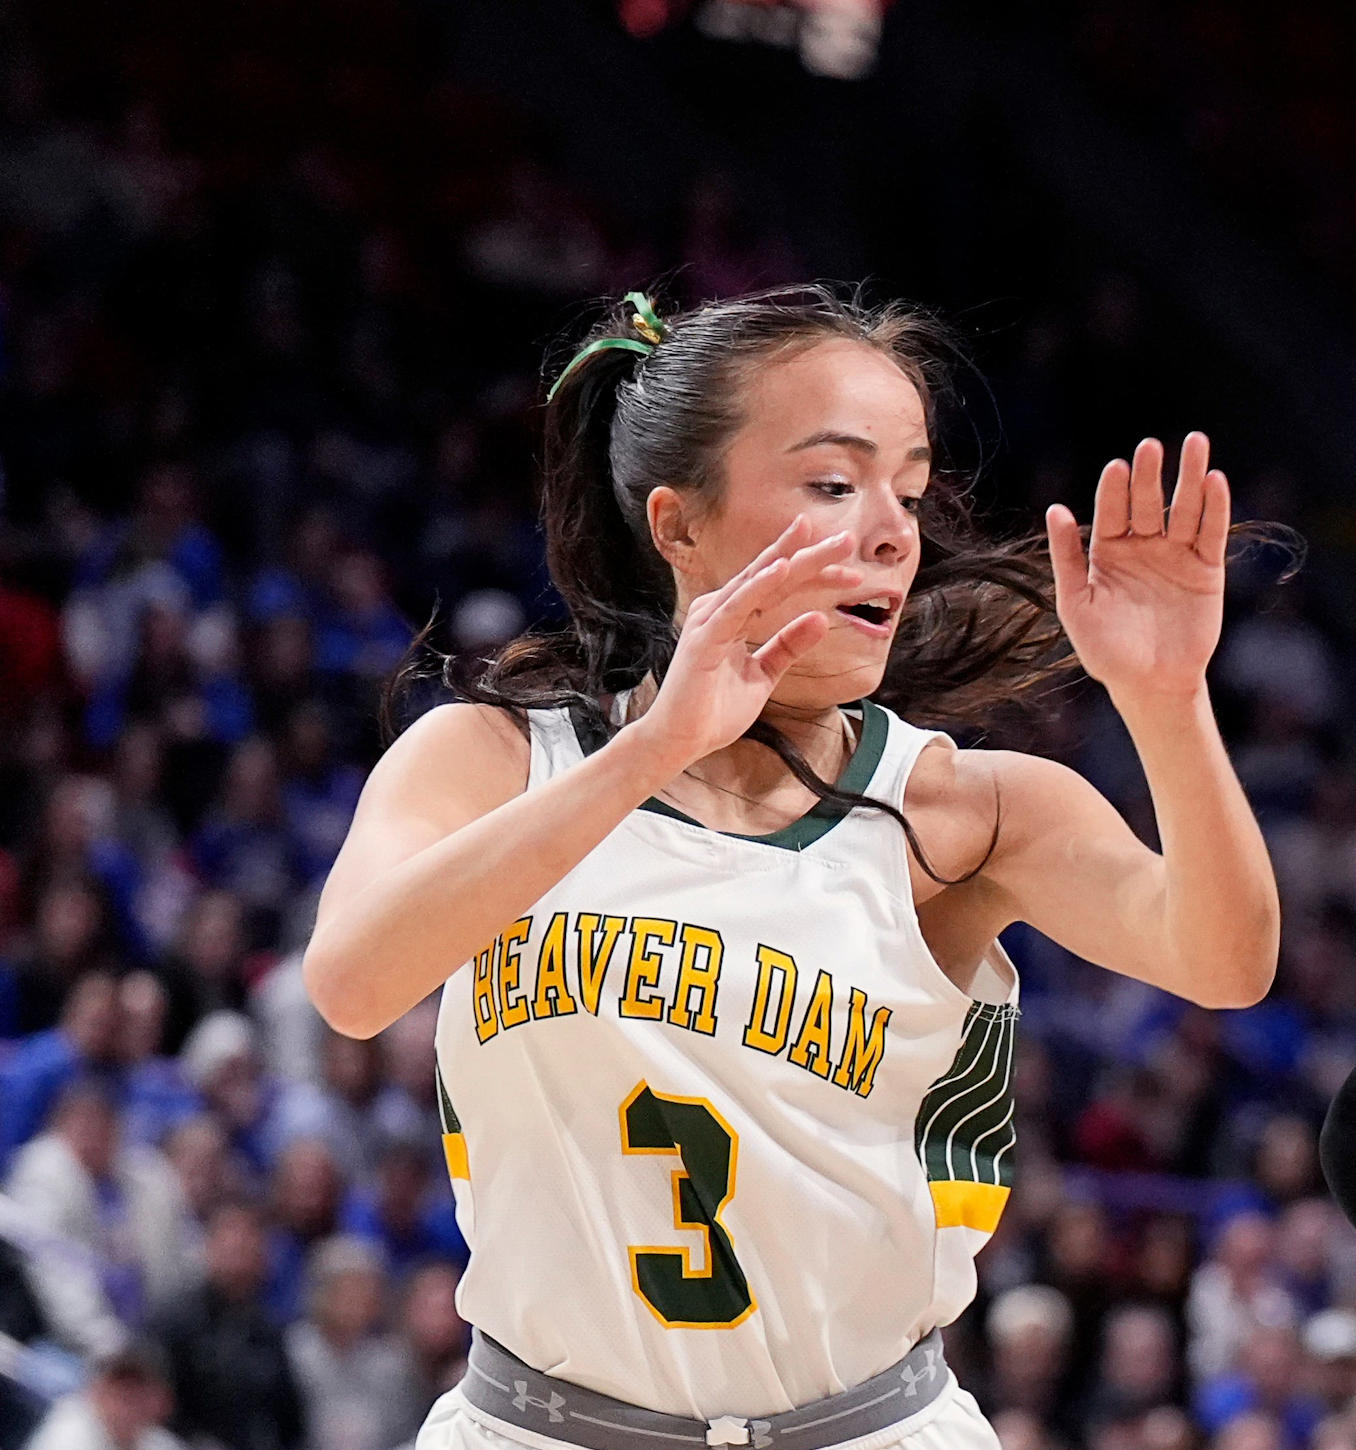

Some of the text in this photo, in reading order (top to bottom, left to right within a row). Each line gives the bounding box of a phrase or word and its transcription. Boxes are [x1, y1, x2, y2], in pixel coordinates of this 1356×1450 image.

[473, 911, 893, 1099] BEAVER DAM
[617, 1077, 757, 1329] 3
